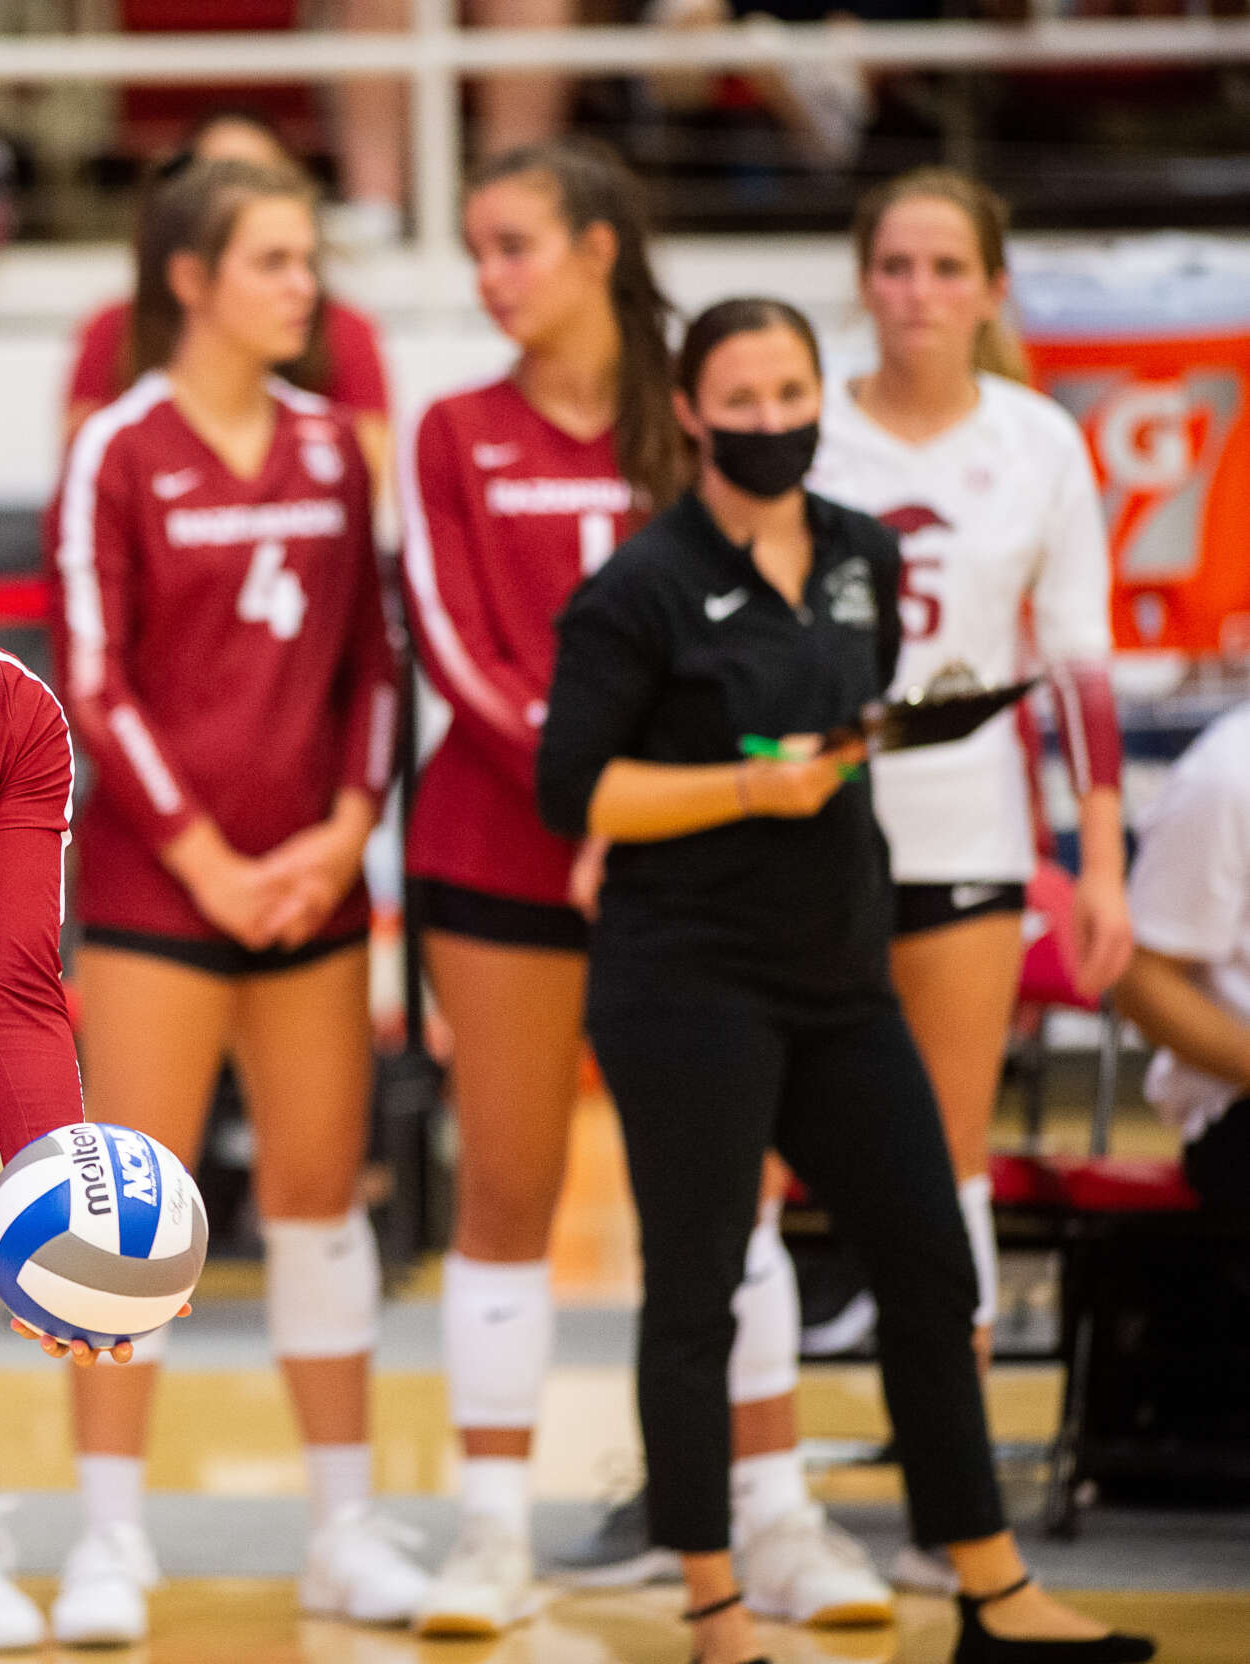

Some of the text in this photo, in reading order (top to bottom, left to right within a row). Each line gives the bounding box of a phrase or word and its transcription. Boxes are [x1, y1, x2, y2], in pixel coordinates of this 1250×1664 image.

[1102, 388, 1190, 486] G
[237, 540, 306, 641] 4
[70, 1126, 112, 1216] molten
